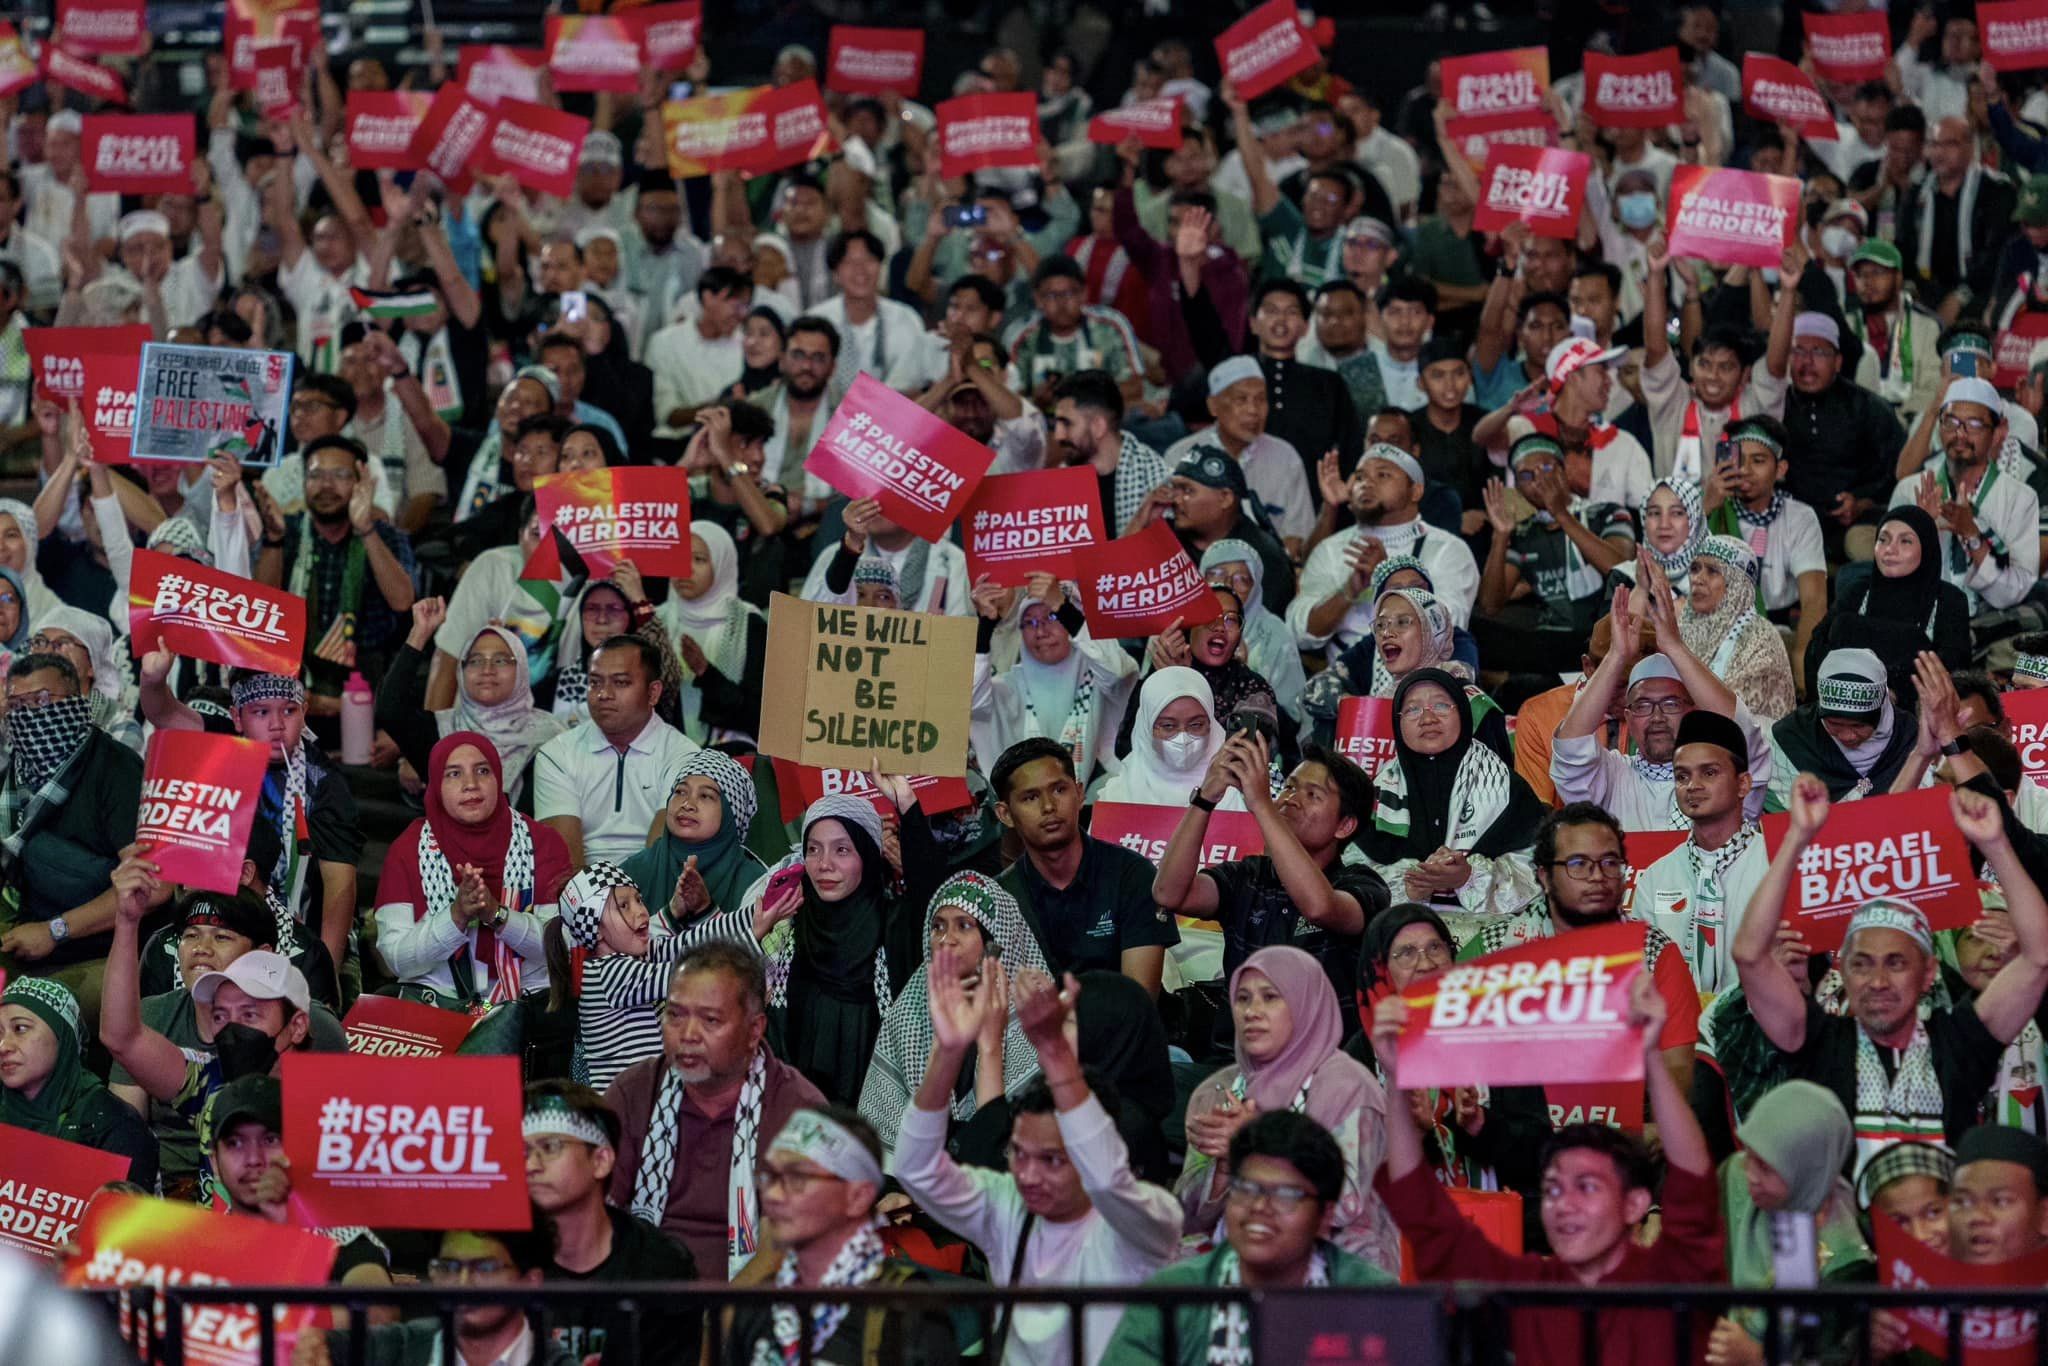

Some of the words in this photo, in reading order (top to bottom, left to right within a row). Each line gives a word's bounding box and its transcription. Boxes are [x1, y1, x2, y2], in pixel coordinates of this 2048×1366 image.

[1682, 192, 1788, 220] #PALESTIN
[1678, 212, 1784, 239] MERDEKA
[156, 370, 199, 398] FREE
[152, 398, 252, 433] PALESTINE
[834, 429, 951, 509] MERDEKA
[848, 411, 965, 490] #PALESTIN
[554, 502, 679, 526] #PALESTIN
[973, 503, 1089, 531] #PALESTIN
[973, 522, 1093, 552] MERDEKA
[1096, 549, 1192, 592] #PALESTIN
[1098, 566, 1202, 611] MERDEKA
[153, 590, 287, 637] BACUL
[157, 573, 285, 617] #ISRAEL
[818, 607, 858, 636] WE
[865, 614, 927, 645] WILL
[816, 642, 890, 677] NOT
[2023, 660, 2048, 679] GAZ
[855, 678, 897, 710] BE
[1851, 689, 1881, 700] GAZA
[805, 709, 939, 755] SILENCED
[1334, 736, 1396, 756] LESTI
[143, 778, 242, 812] ALESTIN
[139, 802, 231, 840] RDEKA
[1120, 833, 1243, 865] #ISEL
[1796, 830, 1941, 876] #ISRAEL
[1801, 853, 1953, 909] BACUL
[1437, 956, 1613, 993] #ISRAEL
[1430, 984, 1619, 1029] BACUL
[318, 1096, 493, 1135] #ISRAEL
[1547, 1104, 1622, 1130] RAEL
[316, 1134, 501, 1177] BACUL
[0, 1179, 85, 1220] ALESTI
[0, 1203, 78, 1247] RDEK
